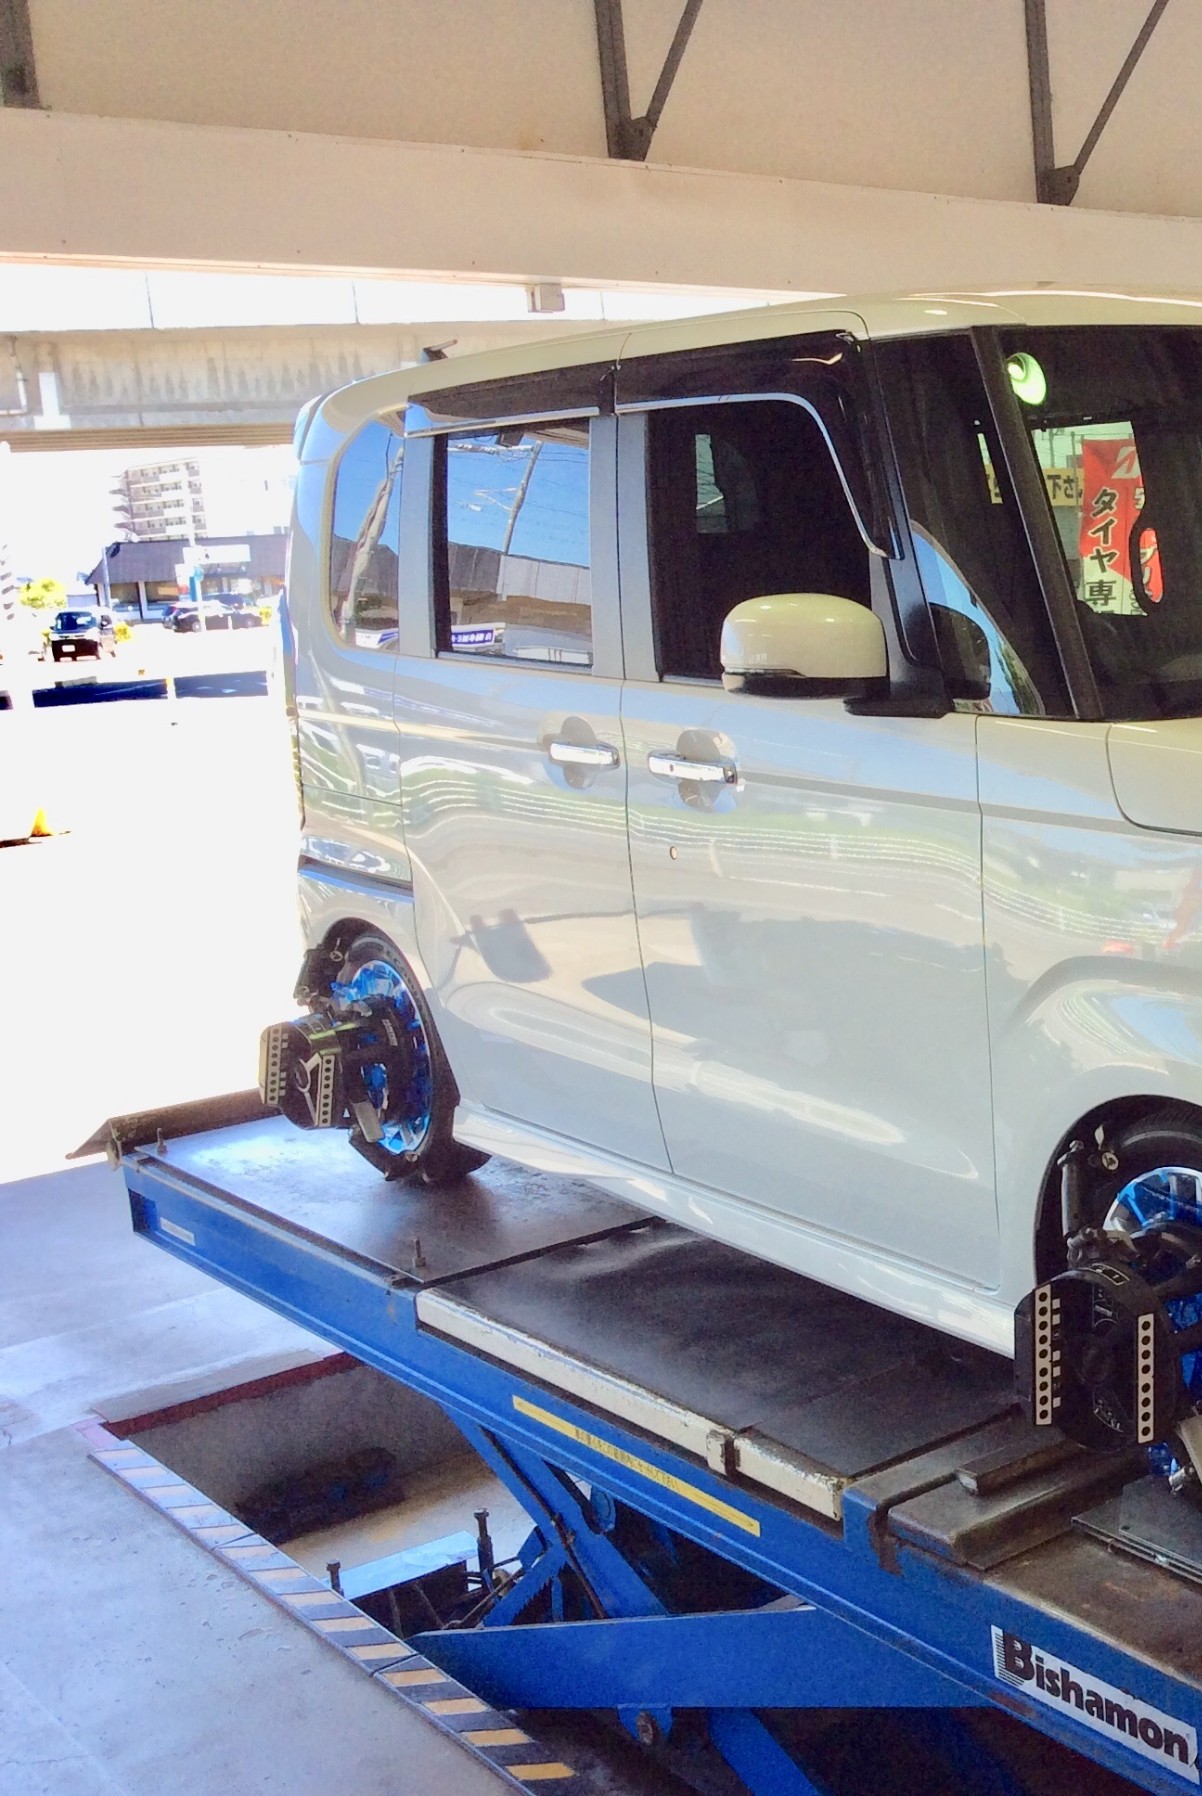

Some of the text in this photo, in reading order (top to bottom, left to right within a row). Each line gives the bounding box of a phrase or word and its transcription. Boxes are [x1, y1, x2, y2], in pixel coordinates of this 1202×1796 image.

[1086, 487, 1119, 613] タイヤ専
[1000, 1629, 1190, 1765] Bishamon
